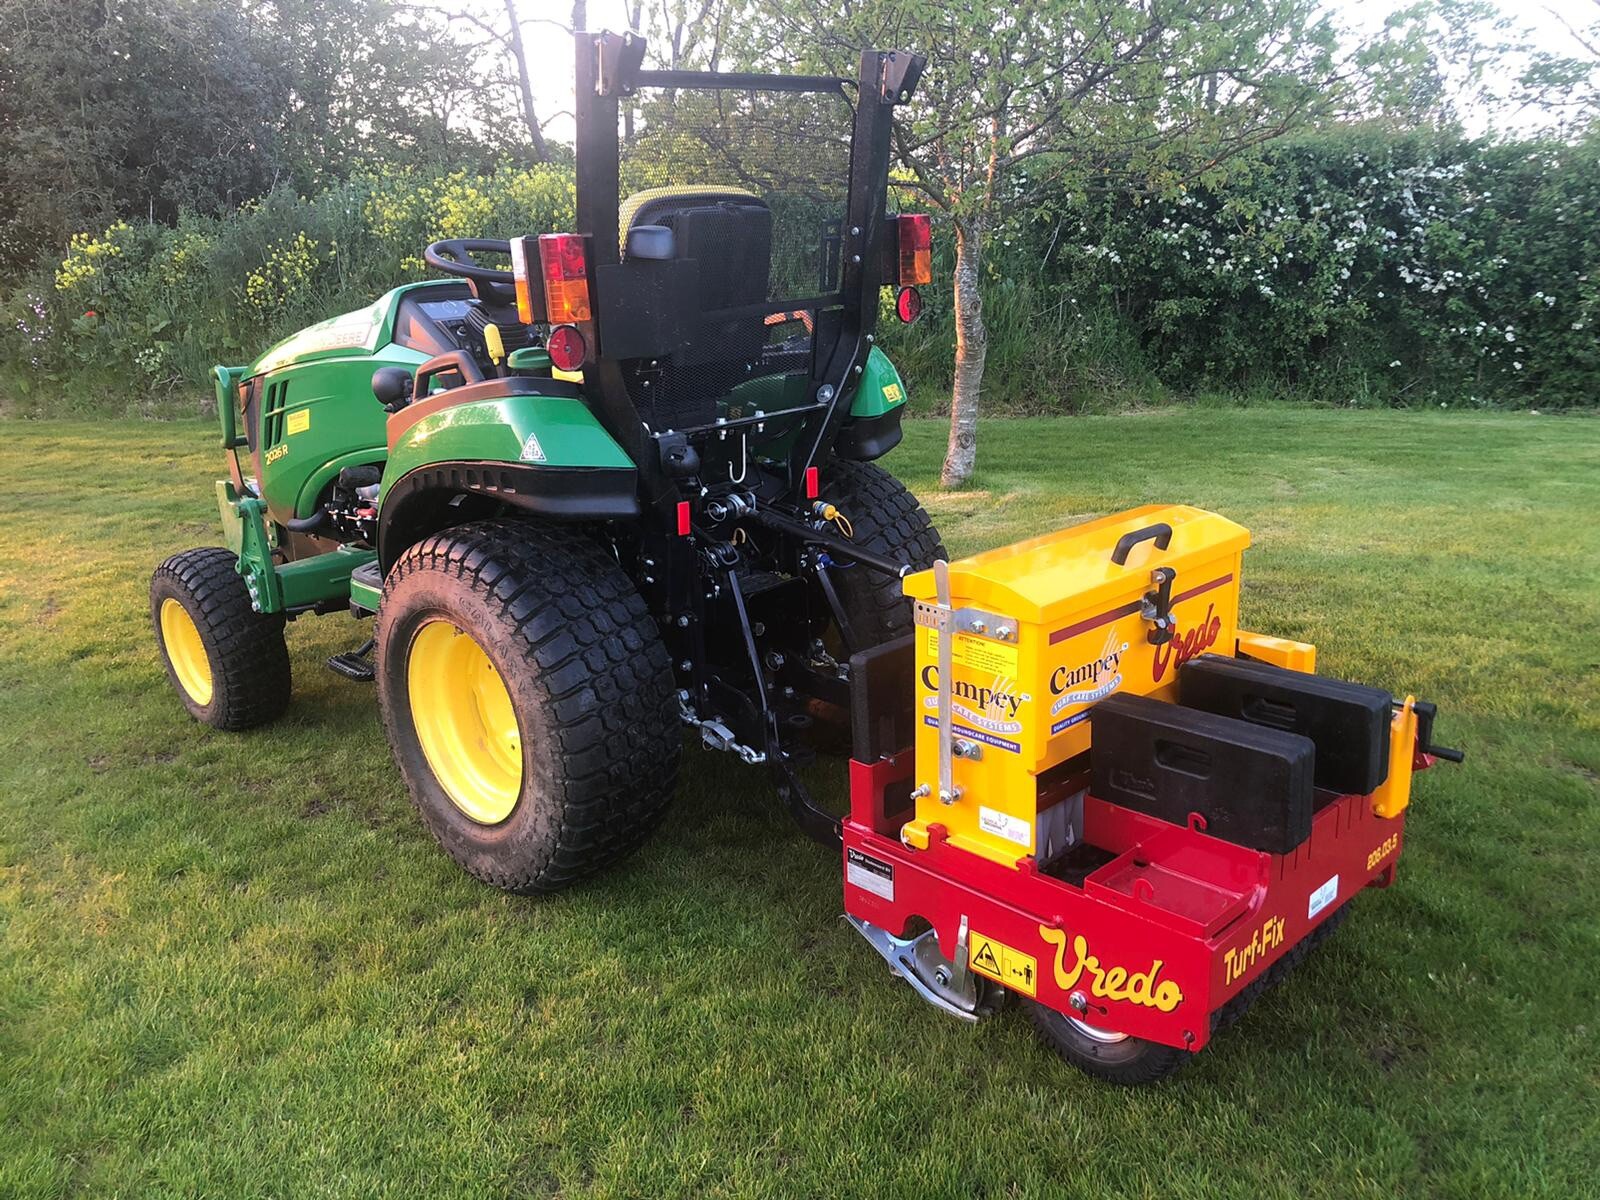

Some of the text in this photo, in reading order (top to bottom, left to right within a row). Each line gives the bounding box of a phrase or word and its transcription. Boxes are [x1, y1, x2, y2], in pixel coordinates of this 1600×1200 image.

[921, 665, 1023, 718] Cmpey
[1050, 650, 1122, 695] Campey
[1091, 679, 1119, 699] SYSTEMS
[977, 719, 1018, 732] SYSTEMS
[1039, 923, 1184, 1012] Vredo
[1224, 914, 1285, 986] Turf-Fix
